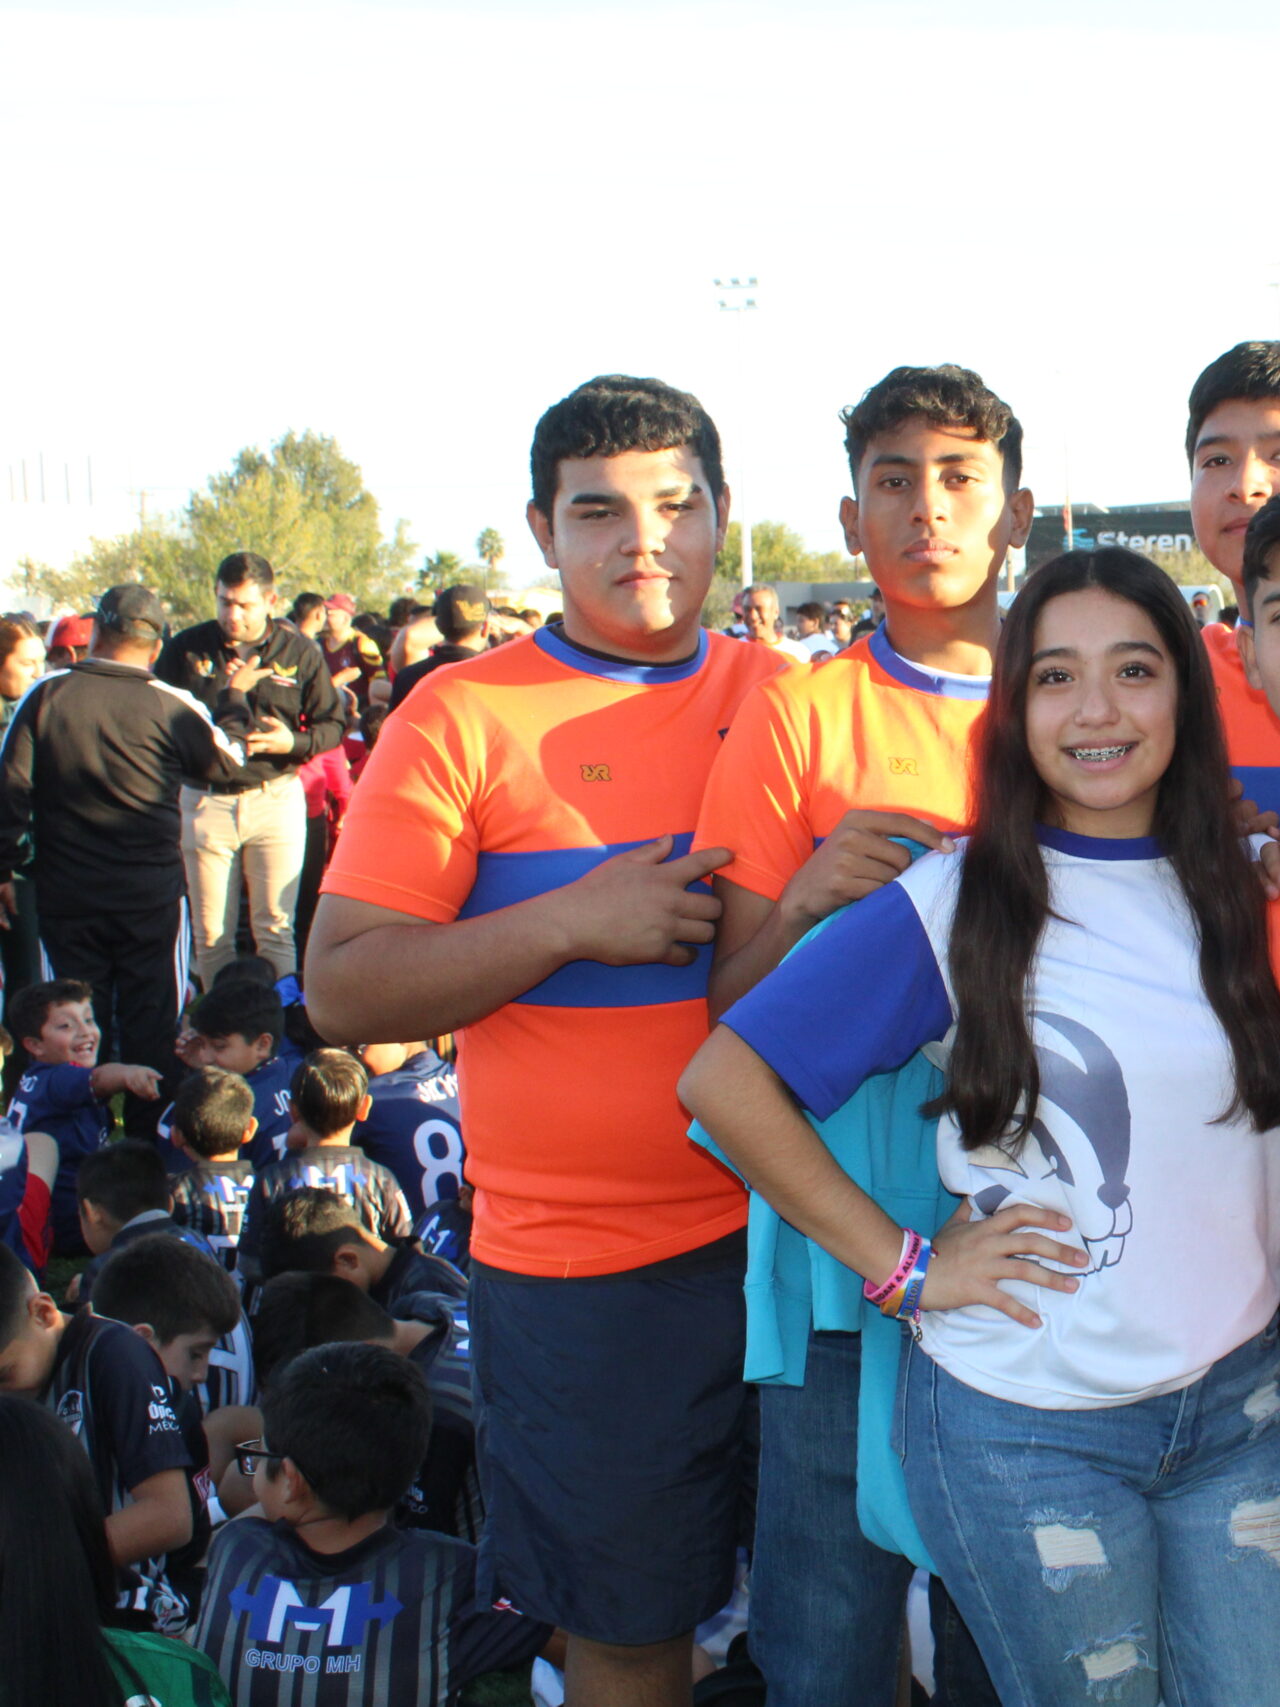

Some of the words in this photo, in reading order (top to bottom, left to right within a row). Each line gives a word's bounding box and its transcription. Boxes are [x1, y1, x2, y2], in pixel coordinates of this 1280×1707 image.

[1097, 530, 1192, 552] Steren
[245, 1648, 320, 1674] GRUPO
[326, 1654, 362, 1674] MH
